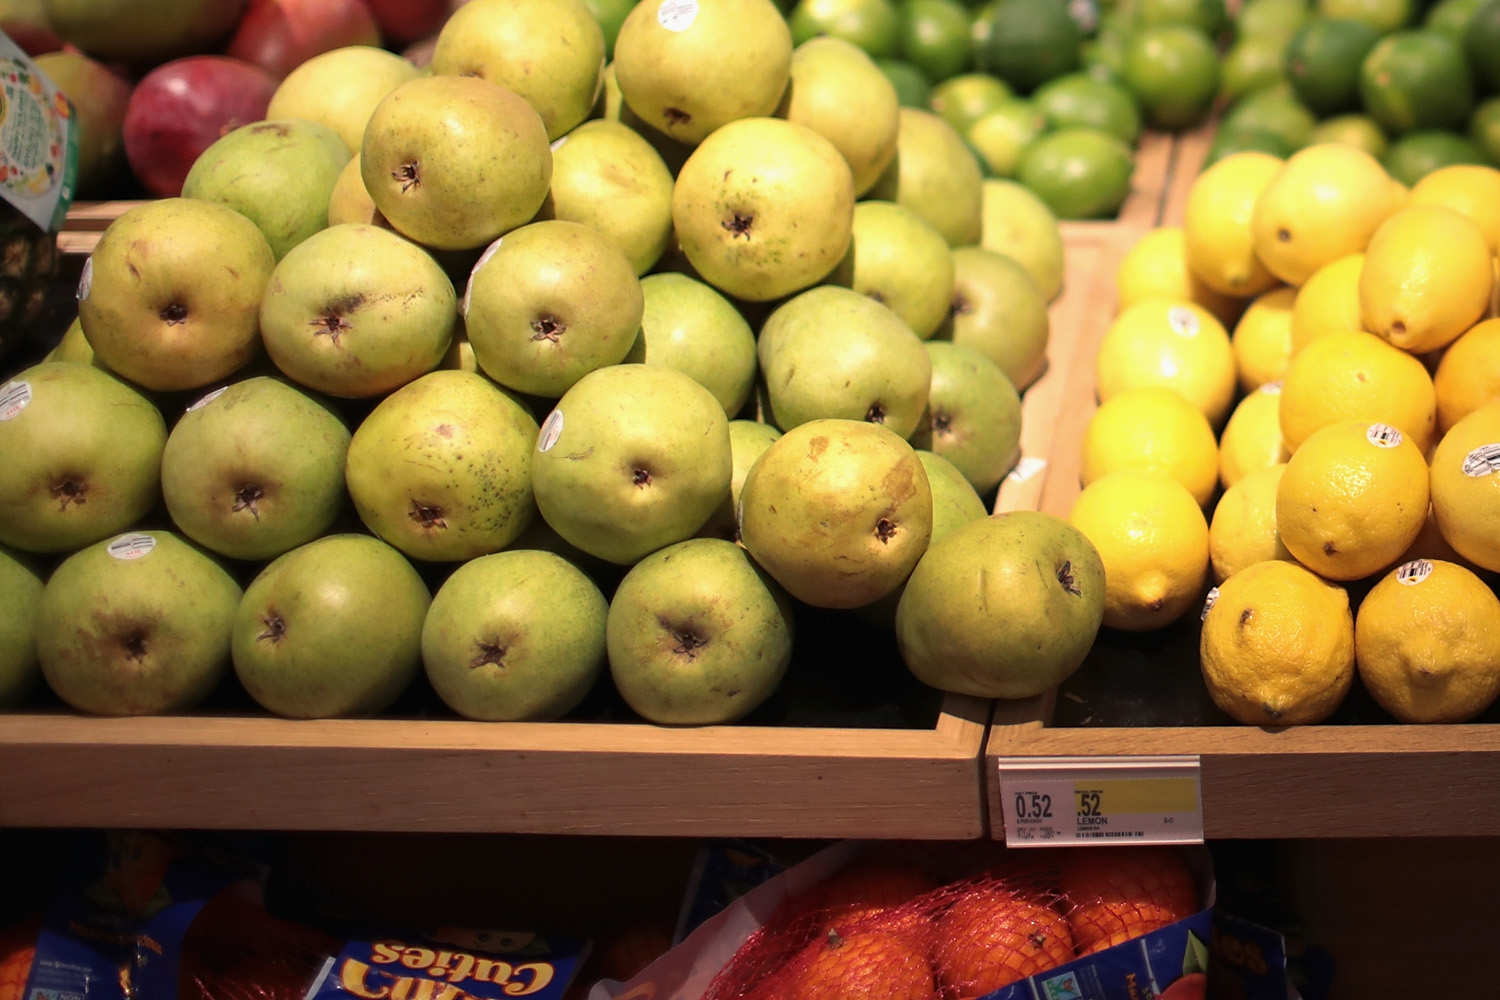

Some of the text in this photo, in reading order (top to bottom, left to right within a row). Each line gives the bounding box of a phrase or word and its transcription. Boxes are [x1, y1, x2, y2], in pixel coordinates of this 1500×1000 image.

[1015, 794, 1052, 818] 0.52
[1077, 793, 1101, 817] .52
[1077, 817, 1108, 825] LEMON
[368, 939, 557, 999] Cuties
